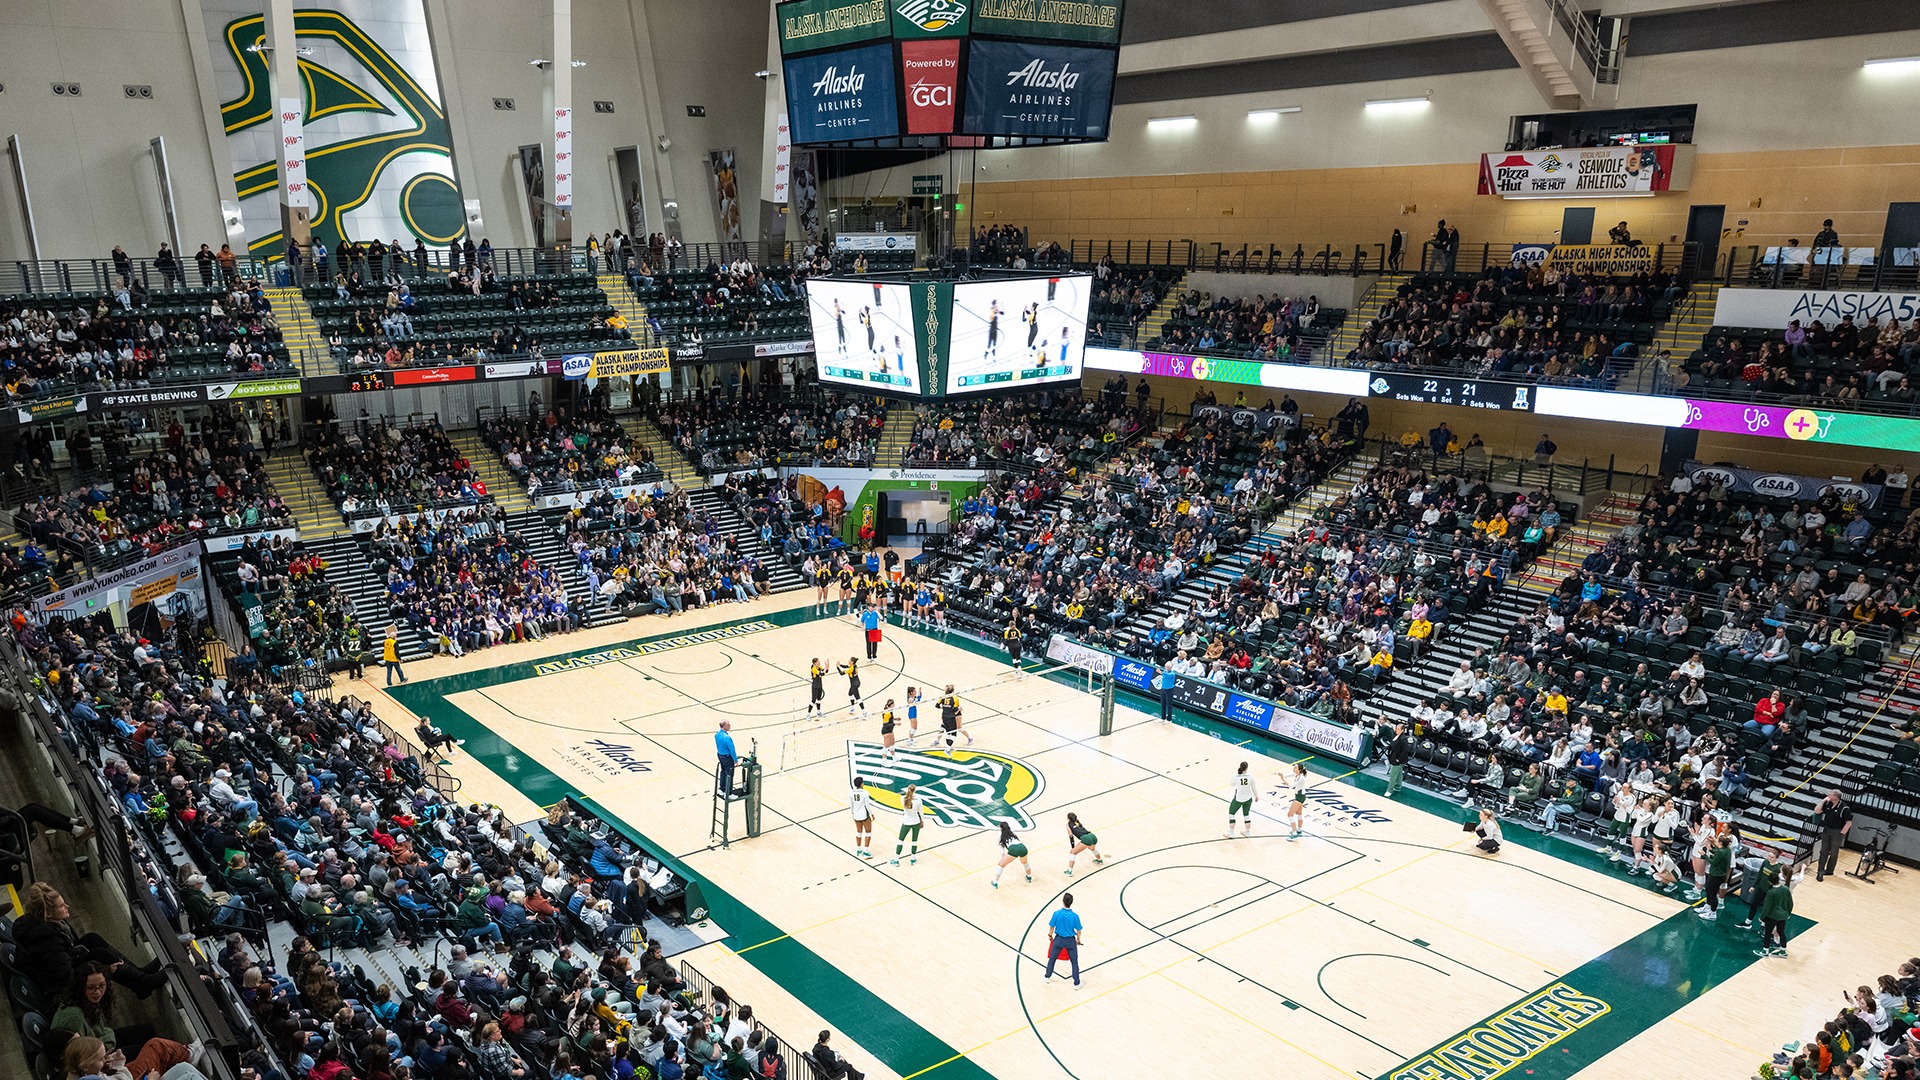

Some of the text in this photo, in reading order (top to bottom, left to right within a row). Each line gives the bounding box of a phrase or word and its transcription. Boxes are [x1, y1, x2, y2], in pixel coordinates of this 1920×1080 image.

[786, 0, 886, 39] ALASKA ANCHORAGE
[979, 0, 1117, 28] ALASKA ANCHORAGE
[906, 58, 956, 70] Powered by
[812, 65, 865, 97] Alaska
[1006, 58, 1080, 92] Alaska
[912, 85, 952, 107] GCI
[1010, 94, 1071, 107] AIRLINES
[817, 99, 863, 112] AIRLINES
[827, 118, 857, 128] CENTER
[1020, 113, 1059, 123] CENTER
[1578, 158, 1624, 174] SEAWOLF
[1497, 167, 1529, 180] Pizza
[1497, 179, 1522, 191] Hut
[1531, 181, 1566, 190] THE HUT
[1576, 174, 1628, 189] ATHLETICS
[1513, 251, 1545, 262] ASAA
[1552, 246, 1652, 260] ALASKA HIGH SCHOOL
[1576, 260, 1652, 273] CHAMPIONSHIPS
[925, 285, 939, 395] SEAWOLVES
[596, 350, 666, 365] ALASKA HIGH SCHOOL
[564, 359, 591, 371] ASAA
[596, 359, 668, 376] STATE CHAMPIONSHIPS
[351, 383, 361, 391] 22
[366, 382, 370, 390] 3
[1423, 380, 1476, 396] 22 21
[1445, 388, 1451, 396] 3
[117, 394, 149, 404] STATE
[151, 390, 198, 402] BREWING
[1396, 393, 1409, 401] Sets
[1410, 394, 1424, 402] Won
[1469, 400, 1484, 408] Sets
[1485, 402, 1500, 410] Won
[900, 470, 937, 479] Providence
[1757, 478, 1795, 491] ASAA
[1833, 486, 1863, 500] SAA
[72, 561, 157, 598] WWW.YUKONEQ.COM
[180, 566, 199, 579] CASE
[45, 592, 66, 606] CASE
[348, 640, 361, 652] 22
[534, 620, 776, 676] ALASKA ANCHORAGE
[1120, 662, 1147, 677] Alaska
[1120, 671, 1142, 682] AIRLINES
[1174, 678, 1206, 696] 22 21
[1235, 699, 1266, 715] Alaska
[1235, 709, 1261, 720] AIRLINES
[1306, 728, 1354, 753] Captain Cook
[570, 745, 621, 776] AIRLINES
[584, 739, 653, 772] Alaska
[1240, 778, 1248, 786] 12
[1266, 790, 1362, 828] AILINES
[1271, 802, 1332, 827] CETER
[1390, 982, 1611, 1080] SEAWOLVE
